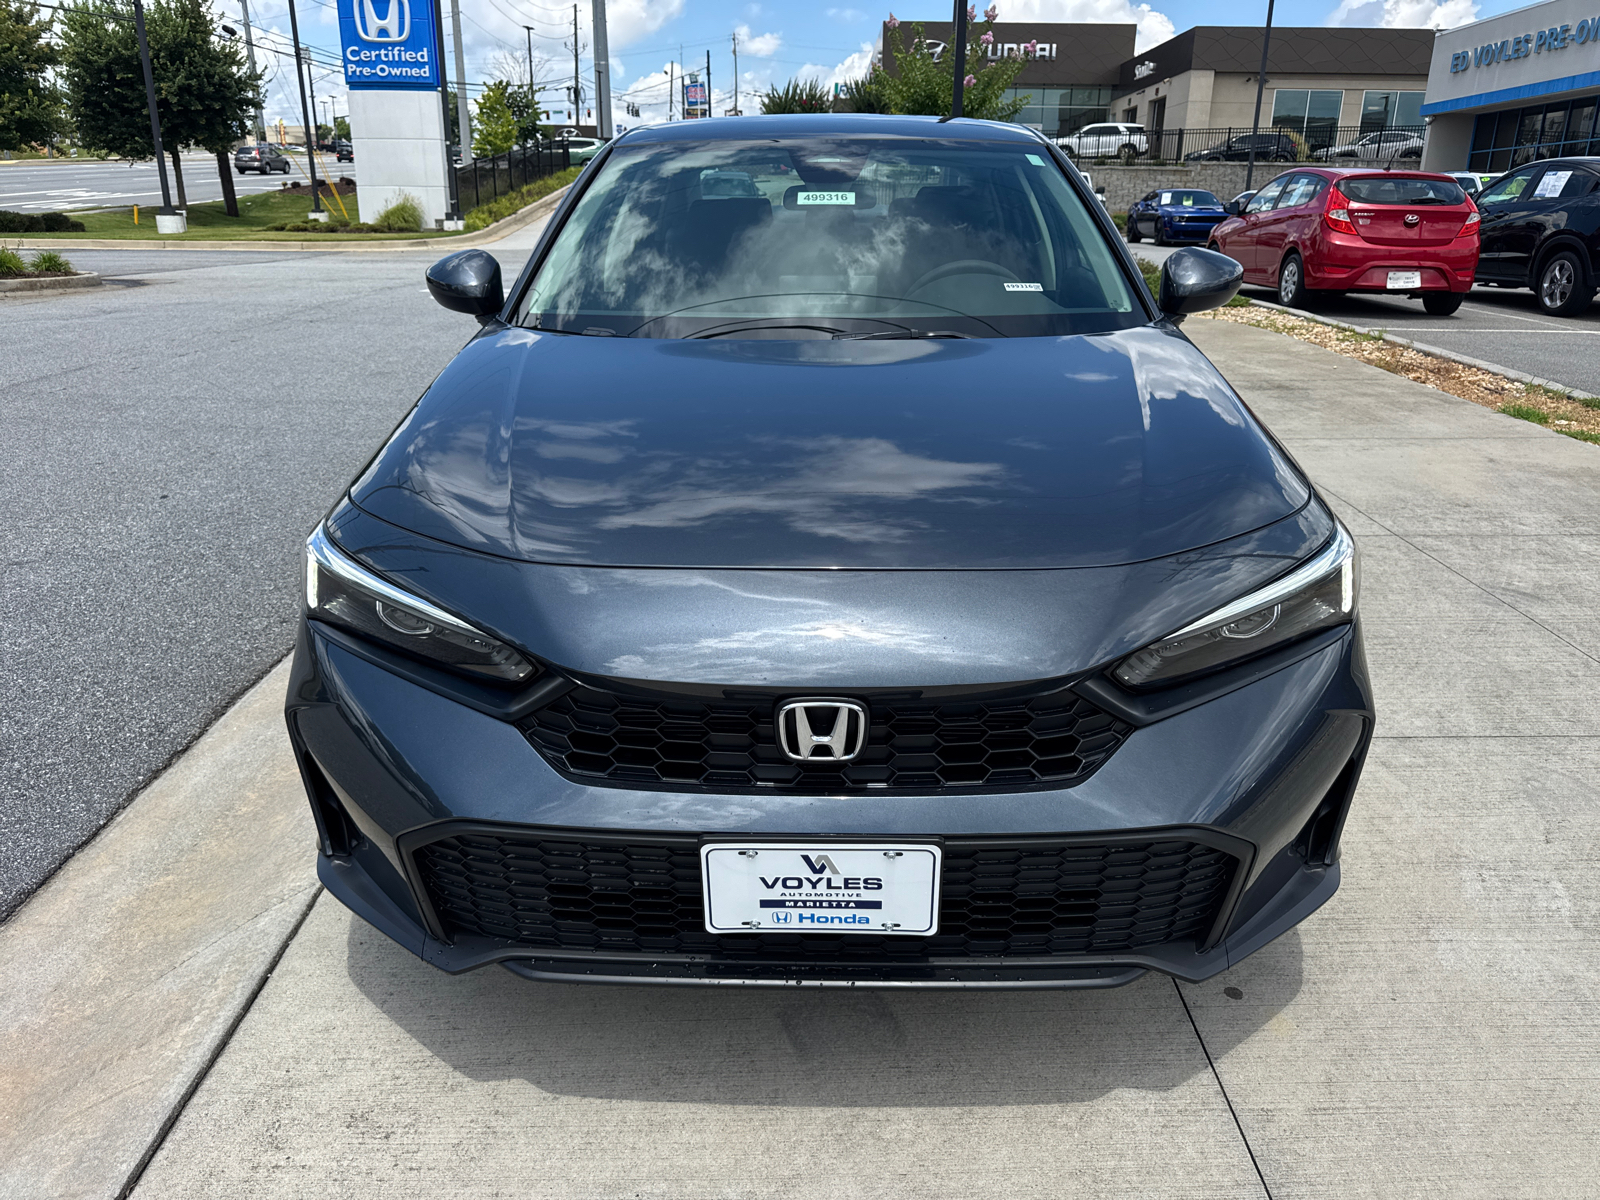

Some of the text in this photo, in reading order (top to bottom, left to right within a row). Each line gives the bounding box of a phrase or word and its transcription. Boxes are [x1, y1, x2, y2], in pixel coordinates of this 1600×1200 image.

[346, 46, 428, 62] Certified
[1450, 51, 1470, 73] ED
[1474, 34, 1533, 68] VOYLES
[347, 64, 430, 77] Pre-Owned
[803, 193, 848, 201] 499316
[759, 877, 882, 890] VOYLES
[799, 913, 870, 925] Honda
